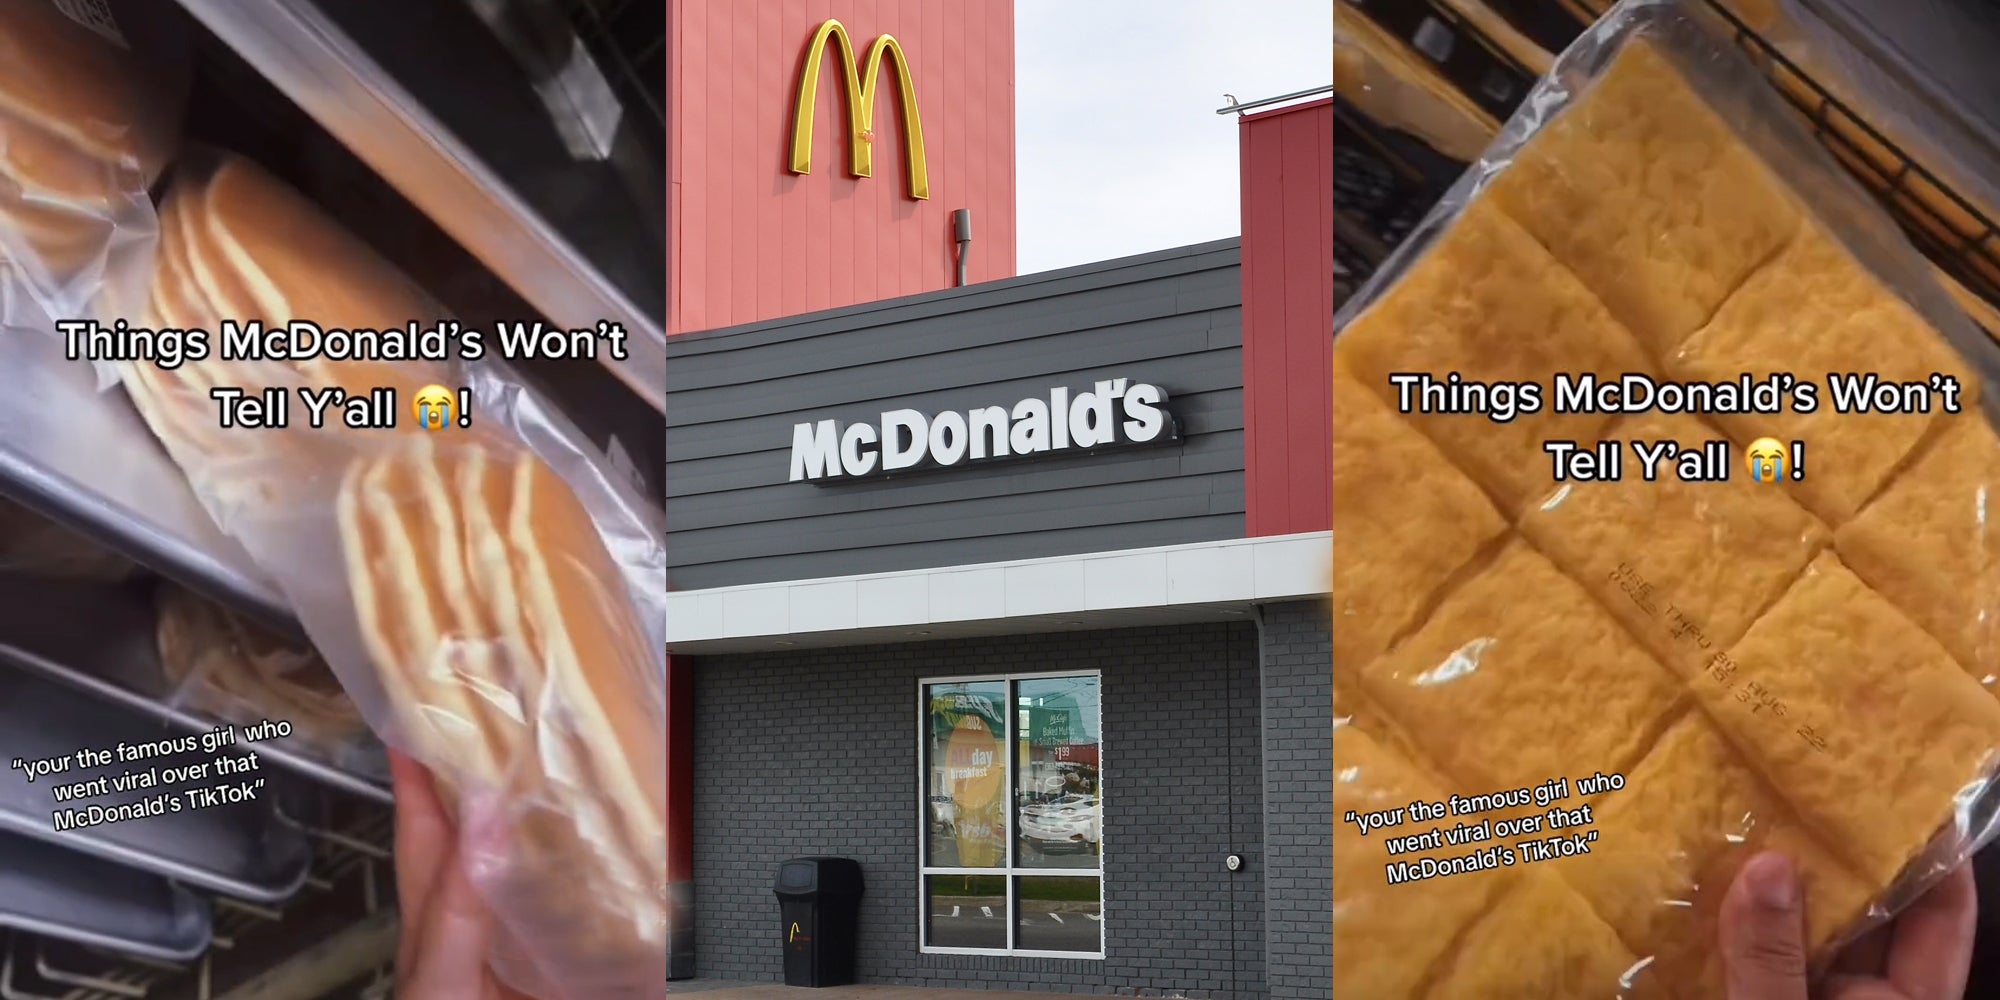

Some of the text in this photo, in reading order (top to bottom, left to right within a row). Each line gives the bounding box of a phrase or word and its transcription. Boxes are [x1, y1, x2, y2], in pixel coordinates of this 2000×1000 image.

[789, 378, 1166, 482] McDonald's
[1617, 561, 1655, 592] USE
[1665, 603, 1712, 650] THRU
[1747, 681, 1787, 716] AUG
[950, 766, 987, 780] breakfast
[972, 748, 993, 768] day
